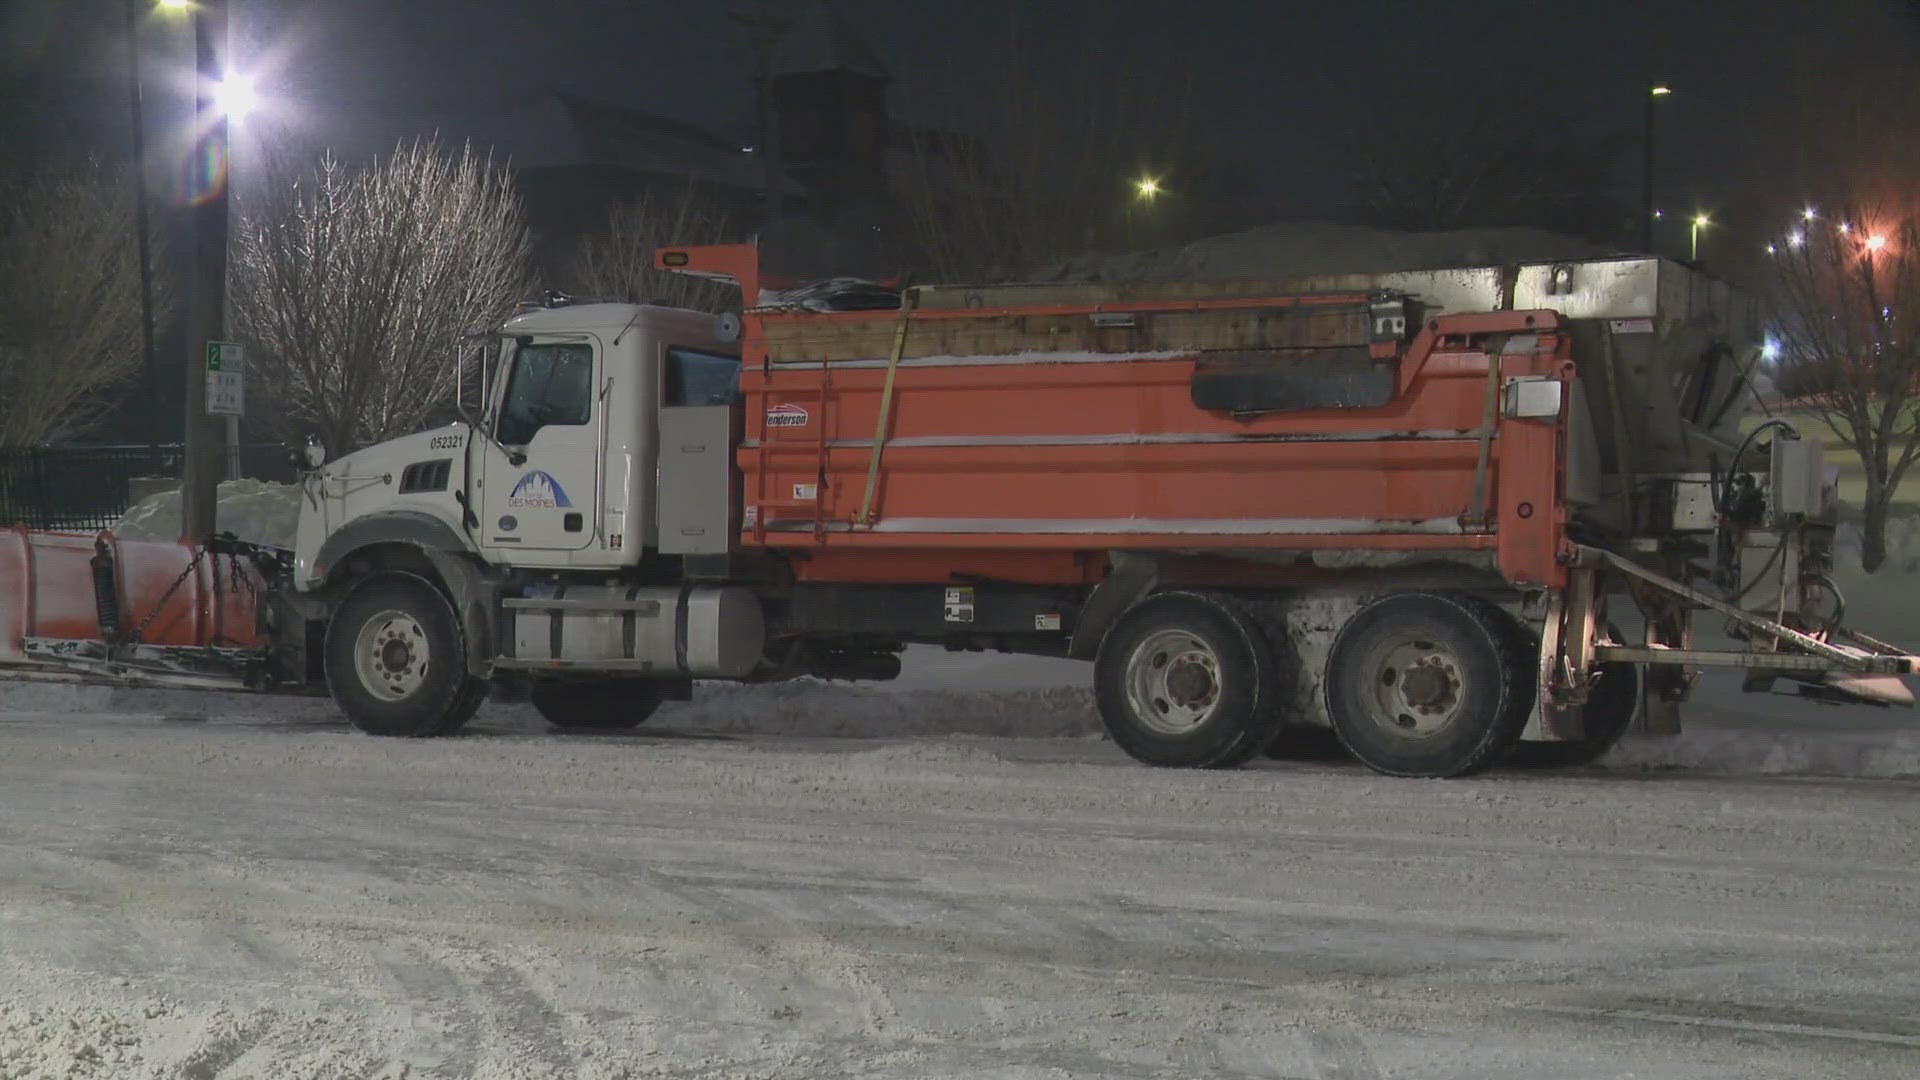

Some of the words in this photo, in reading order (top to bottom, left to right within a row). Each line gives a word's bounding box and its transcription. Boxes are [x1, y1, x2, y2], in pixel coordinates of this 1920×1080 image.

[211, 346, 219, 365] 2
[766, 414, 807, 425] enderson
[430, 435, 463, 449] 052321
[508, 498, 524, 508] DES
[525, 498, 555, 509] MOINES
